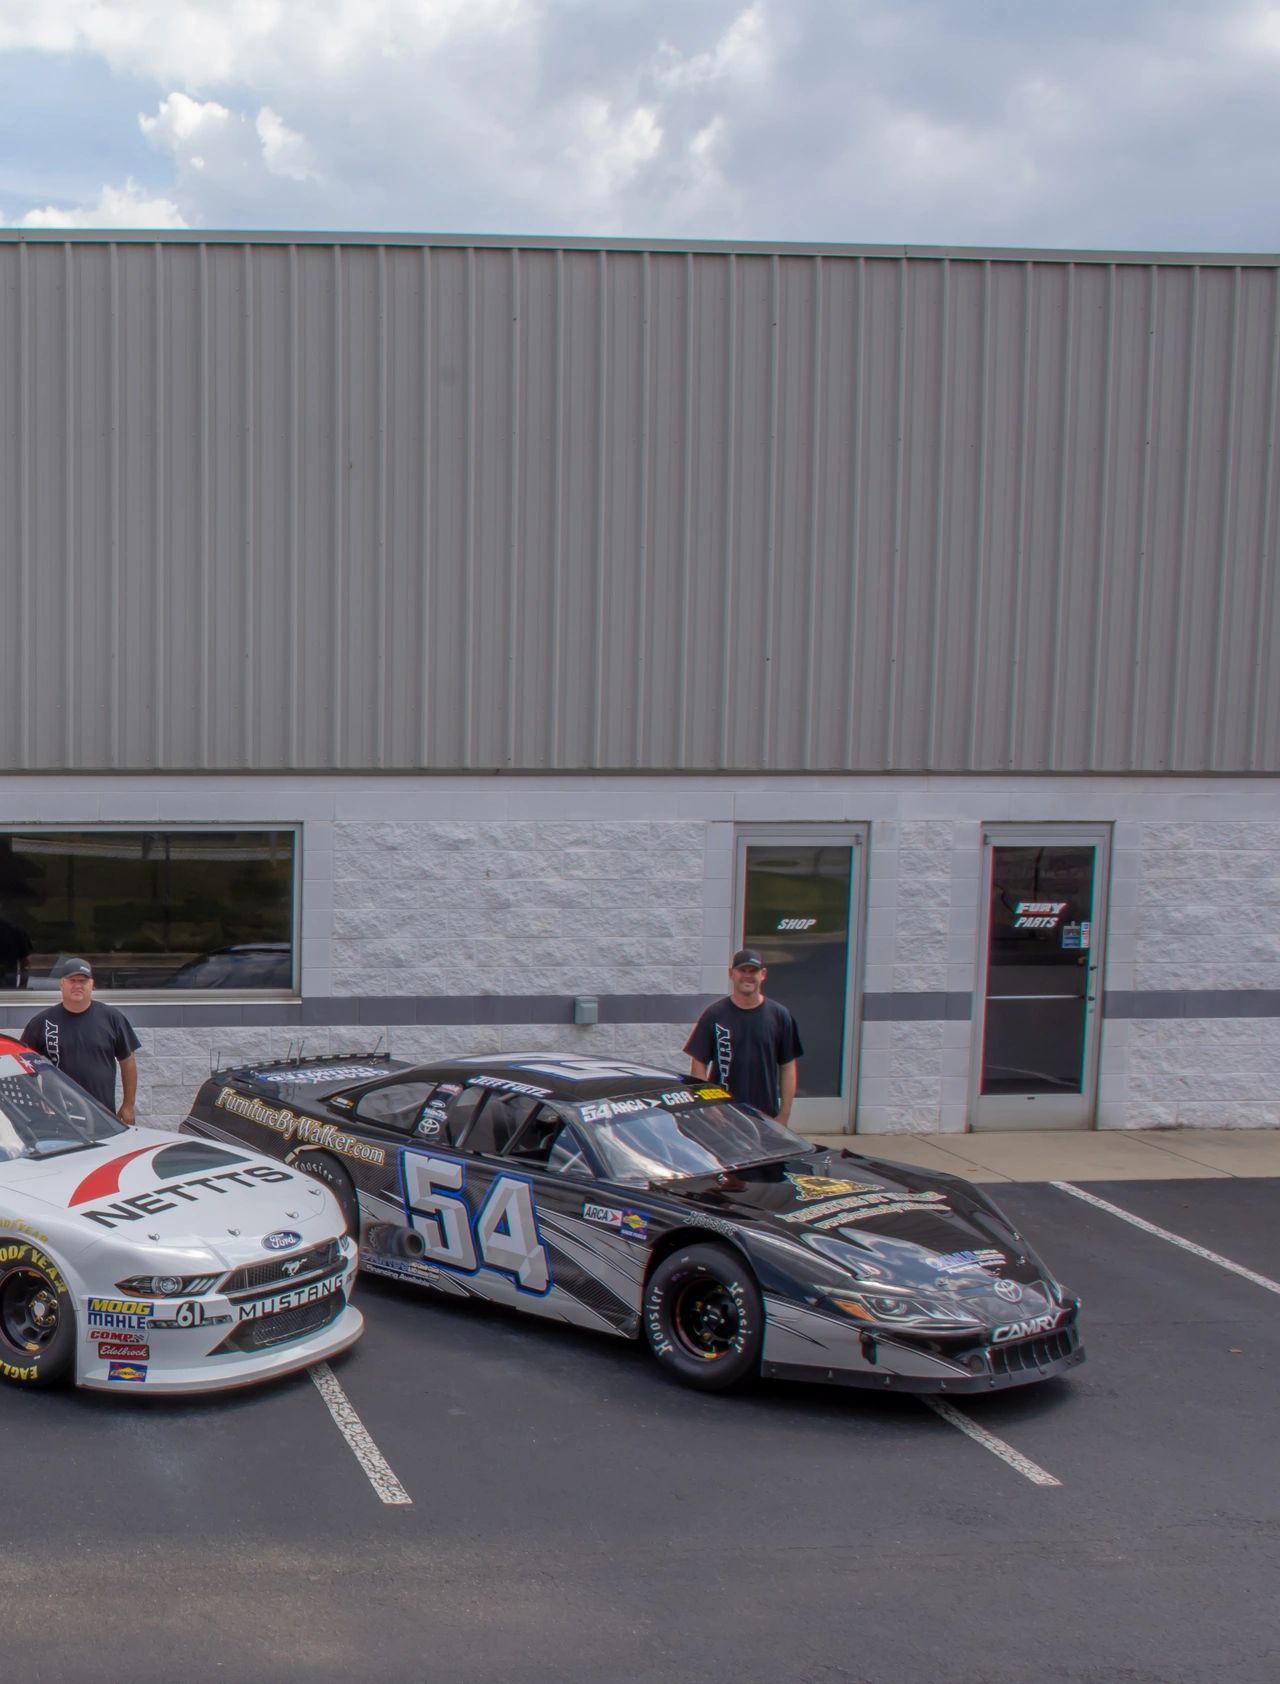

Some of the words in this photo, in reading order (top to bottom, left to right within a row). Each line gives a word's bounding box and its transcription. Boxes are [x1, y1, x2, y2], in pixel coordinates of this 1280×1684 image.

[777, 918, 817, 930] SHOP
[1014, 916, 1059, 928] PARTS
[45, 1019, 60, 1068] URY
[580, 1103, 613, 1123] 54
[610, 1099, 648, 1115] ARCA
[216, 1087, 387, 1166] FurnitureByWalker.com
[80, 1165, 294, 1229] NETTTS
[397, 1147, 554, 1297] 54
[584, 1202, 609, 1221] ARCA
[269, 1232, 298, 1249] Ford
[90, 1299, 151, 1315] MOOG
[238, 1273, 344, 1321] MUSTANG
[87, 1312, 147, 1330] MAHLE
[177, 1302, 200, 1328] 61
[646, 1286, 673, 1356] Hoosier
[726, 1281, 753, 1354] Hoosier
[991, 1312, 1062, 1342] CAMRY
[100, 1345, 148, 1357] Edelbrock
